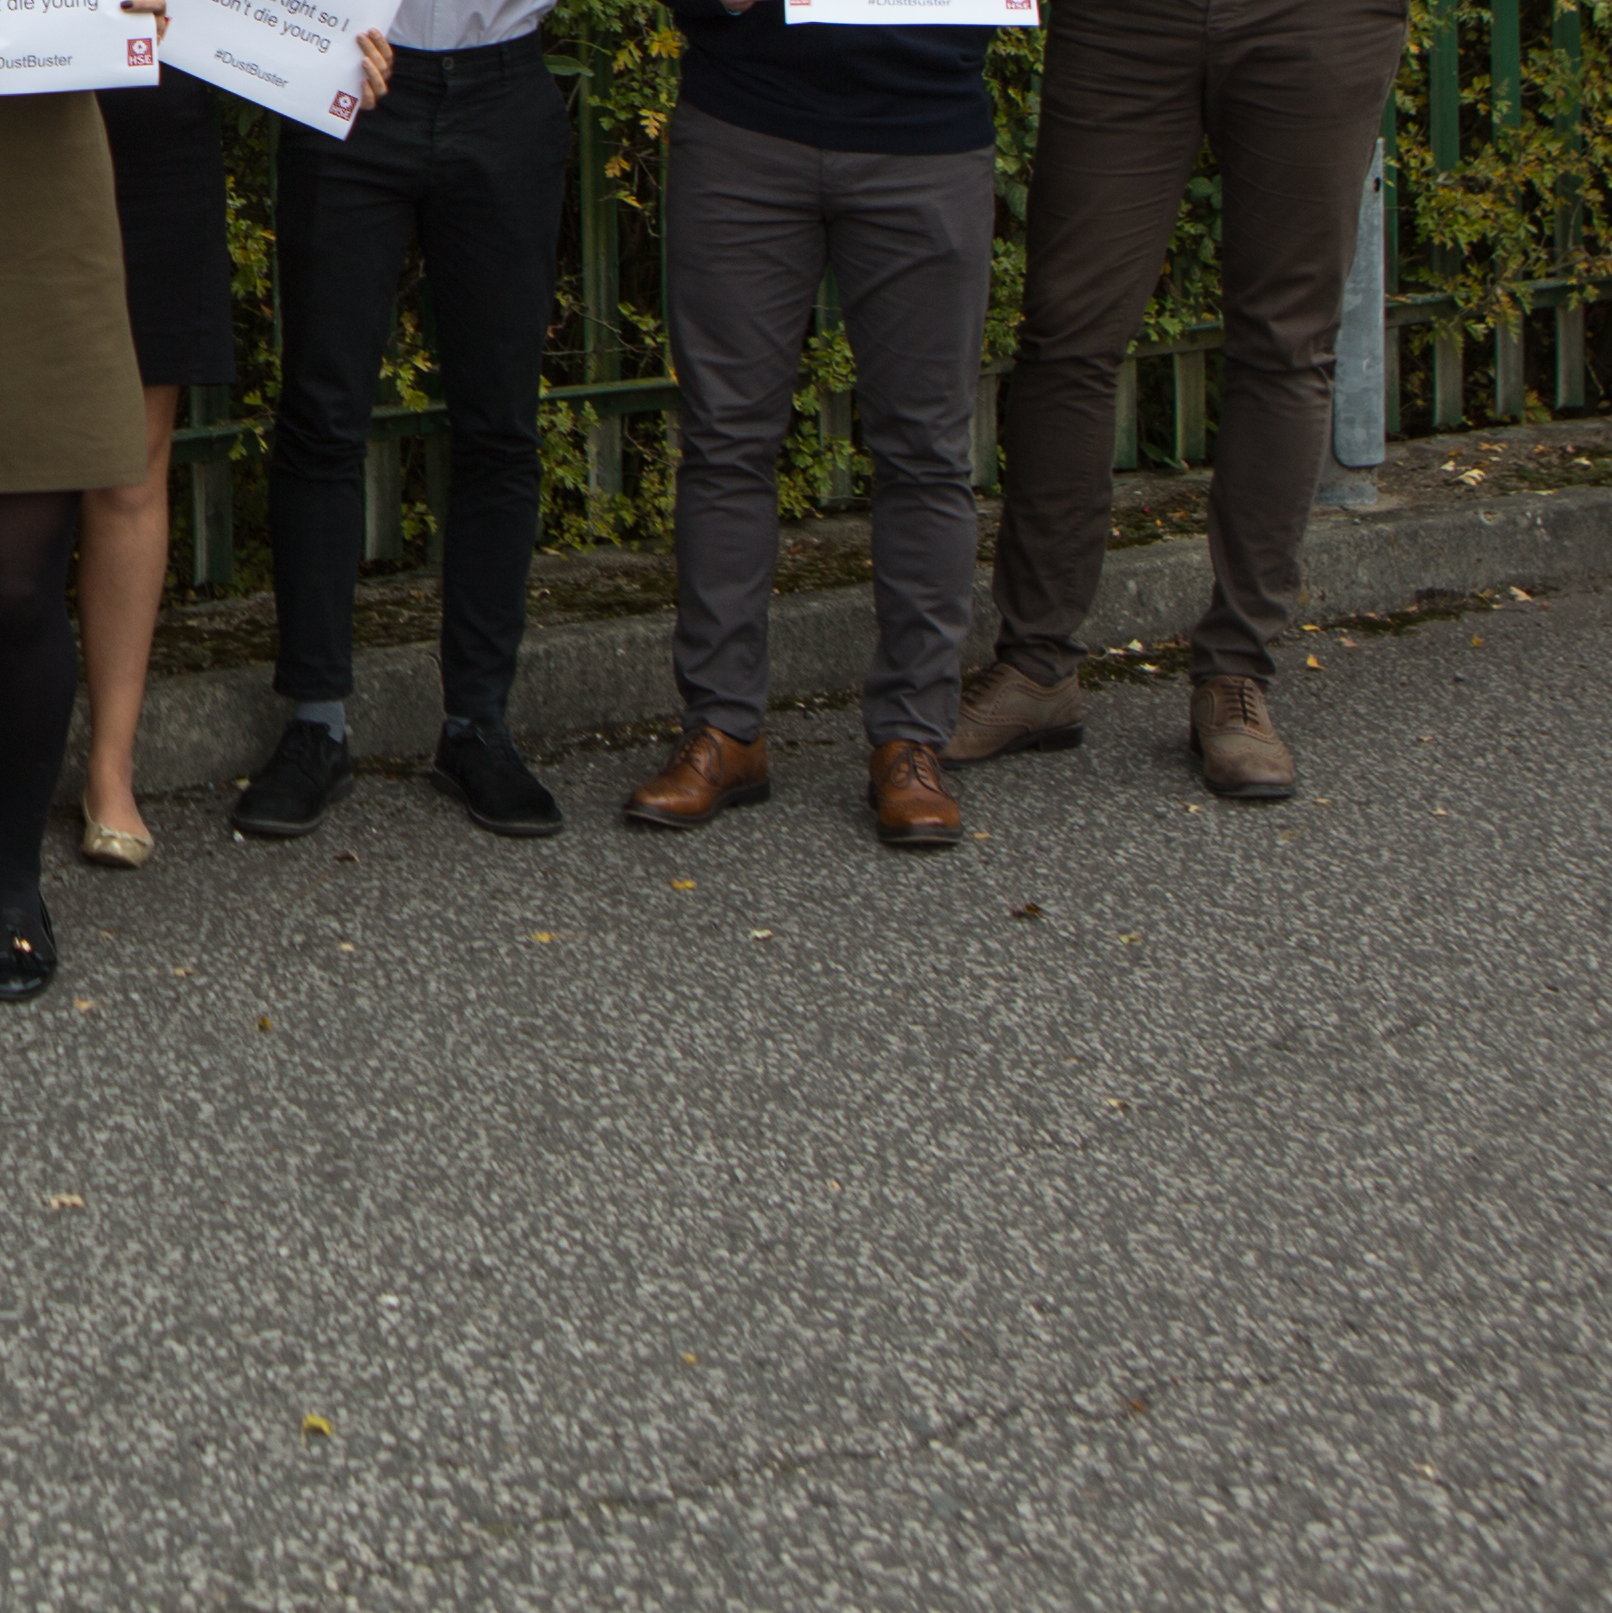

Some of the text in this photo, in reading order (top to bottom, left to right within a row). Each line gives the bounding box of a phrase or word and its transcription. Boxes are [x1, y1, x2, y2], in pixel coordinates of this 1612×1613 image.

[317, 11, 339, 28] so
[253, 7, 279, 27] die
[280, 21, 331, 54] young
[128, 54, 152, 65] HSE
